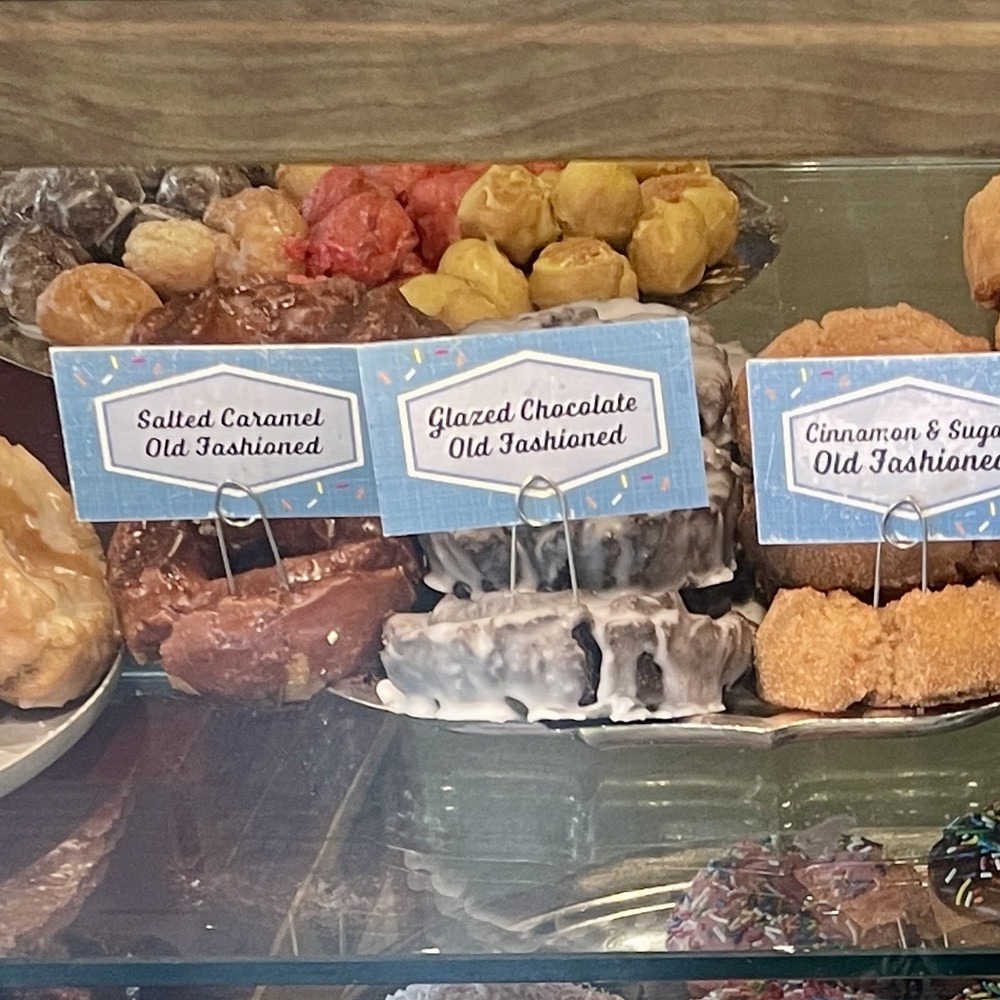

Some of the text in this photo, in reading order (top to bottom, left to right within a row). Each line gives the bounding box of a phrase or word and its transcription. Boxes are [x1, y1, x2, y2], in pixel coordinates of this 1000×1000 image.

[137, 407, 322, 429] Salted Caramel
[427, 393, 639, 439] Glazed Chocolate
[448, 425, 627, 459] Old Fashioned
[806, 421, 920, 444] Cinnamon
[926, 420, 941, 440] &
[145, 435, 322, 457] Old Fashioned
[813, 451, 862, 475] Old
